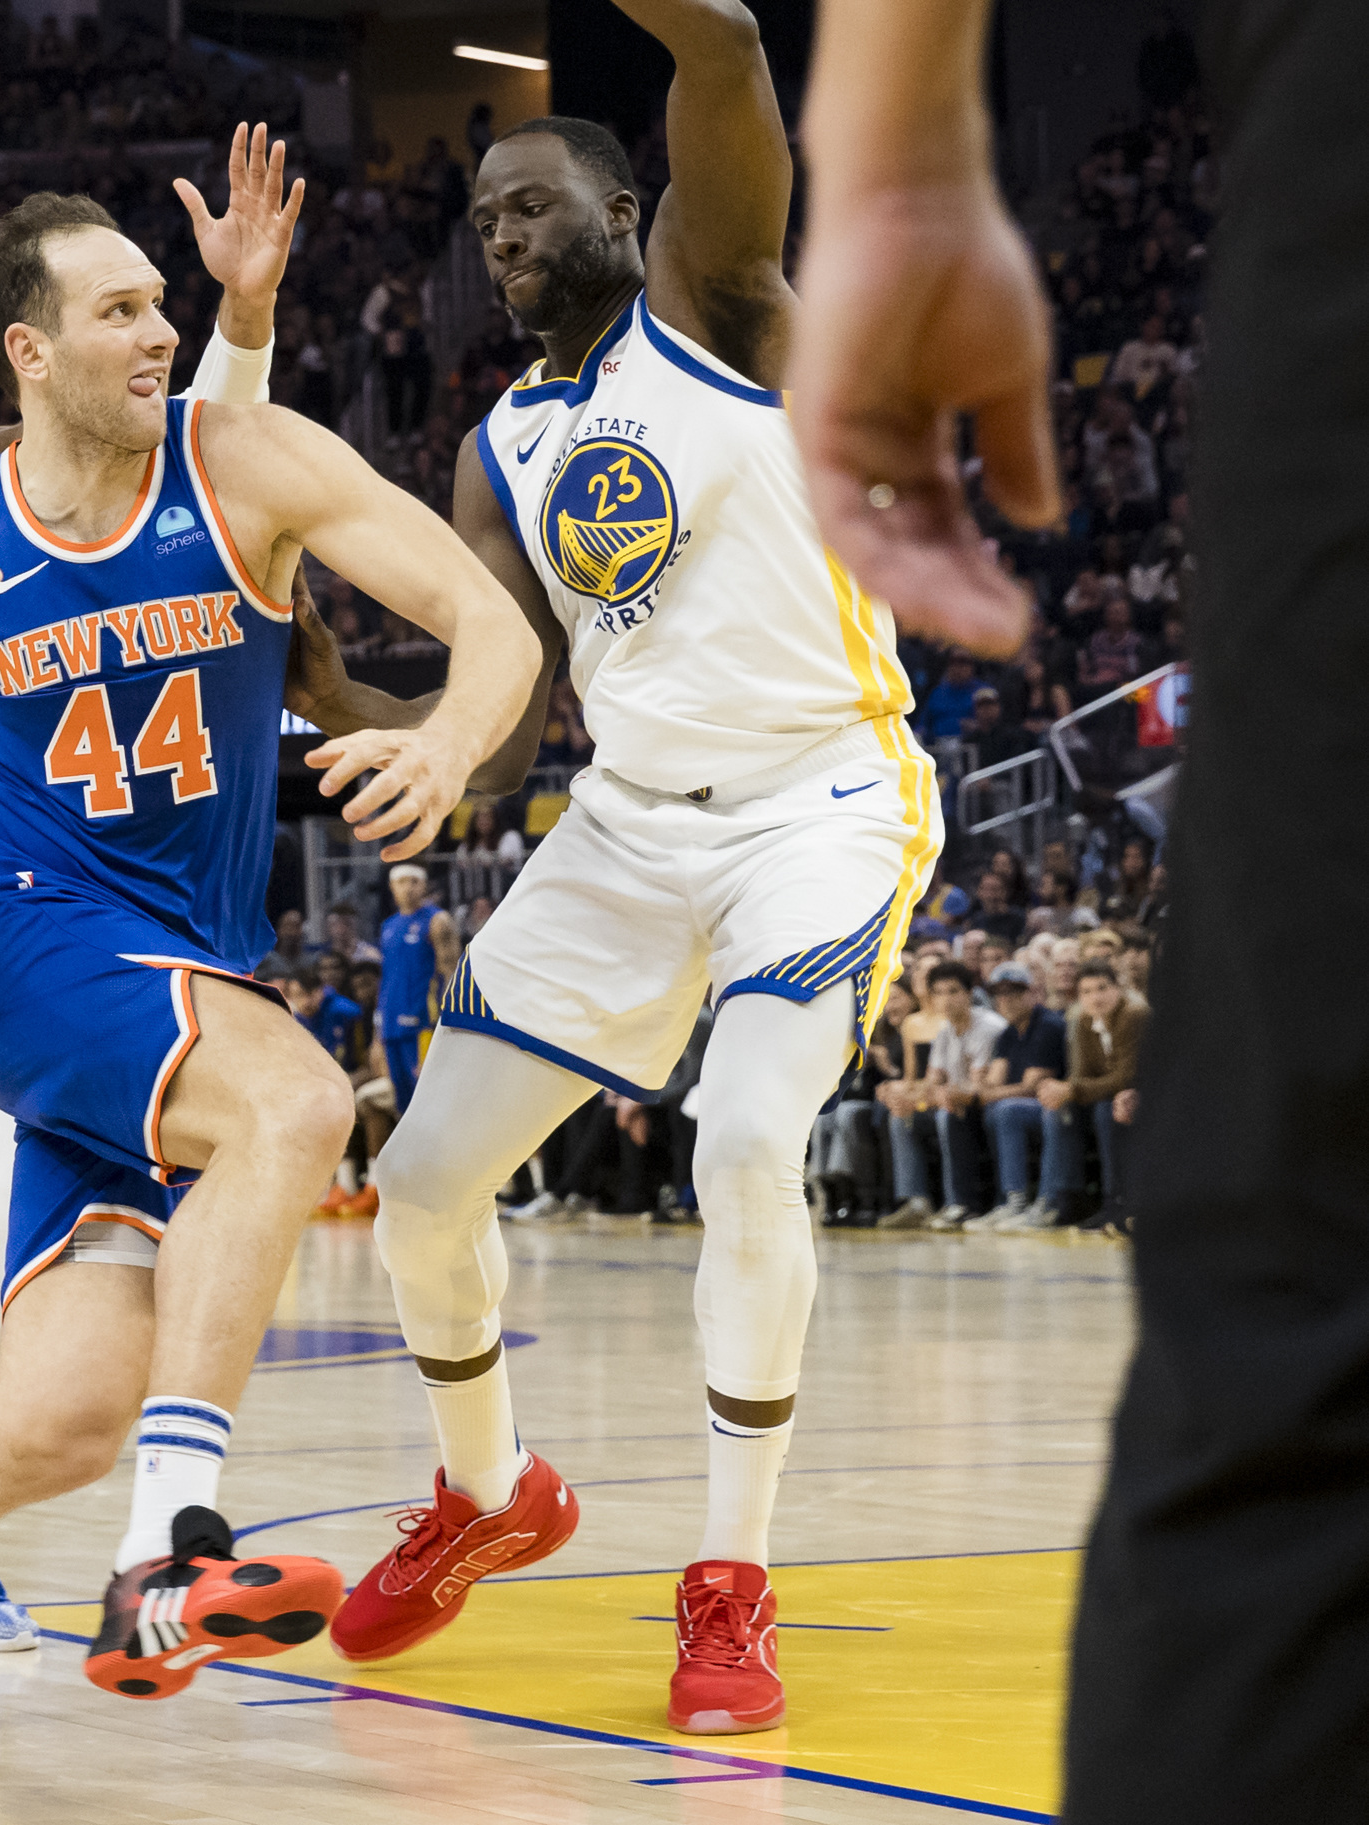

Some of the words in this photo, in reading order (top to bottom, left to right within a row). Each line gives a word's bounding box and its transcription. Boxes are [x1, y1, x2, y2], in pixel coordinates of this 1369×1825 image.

[588, 455, 642, 521] 23
[156, 531, 205, 555] sphere
[105, 591, 244, 667] YORK
[44, 668, 218, 818] 44
